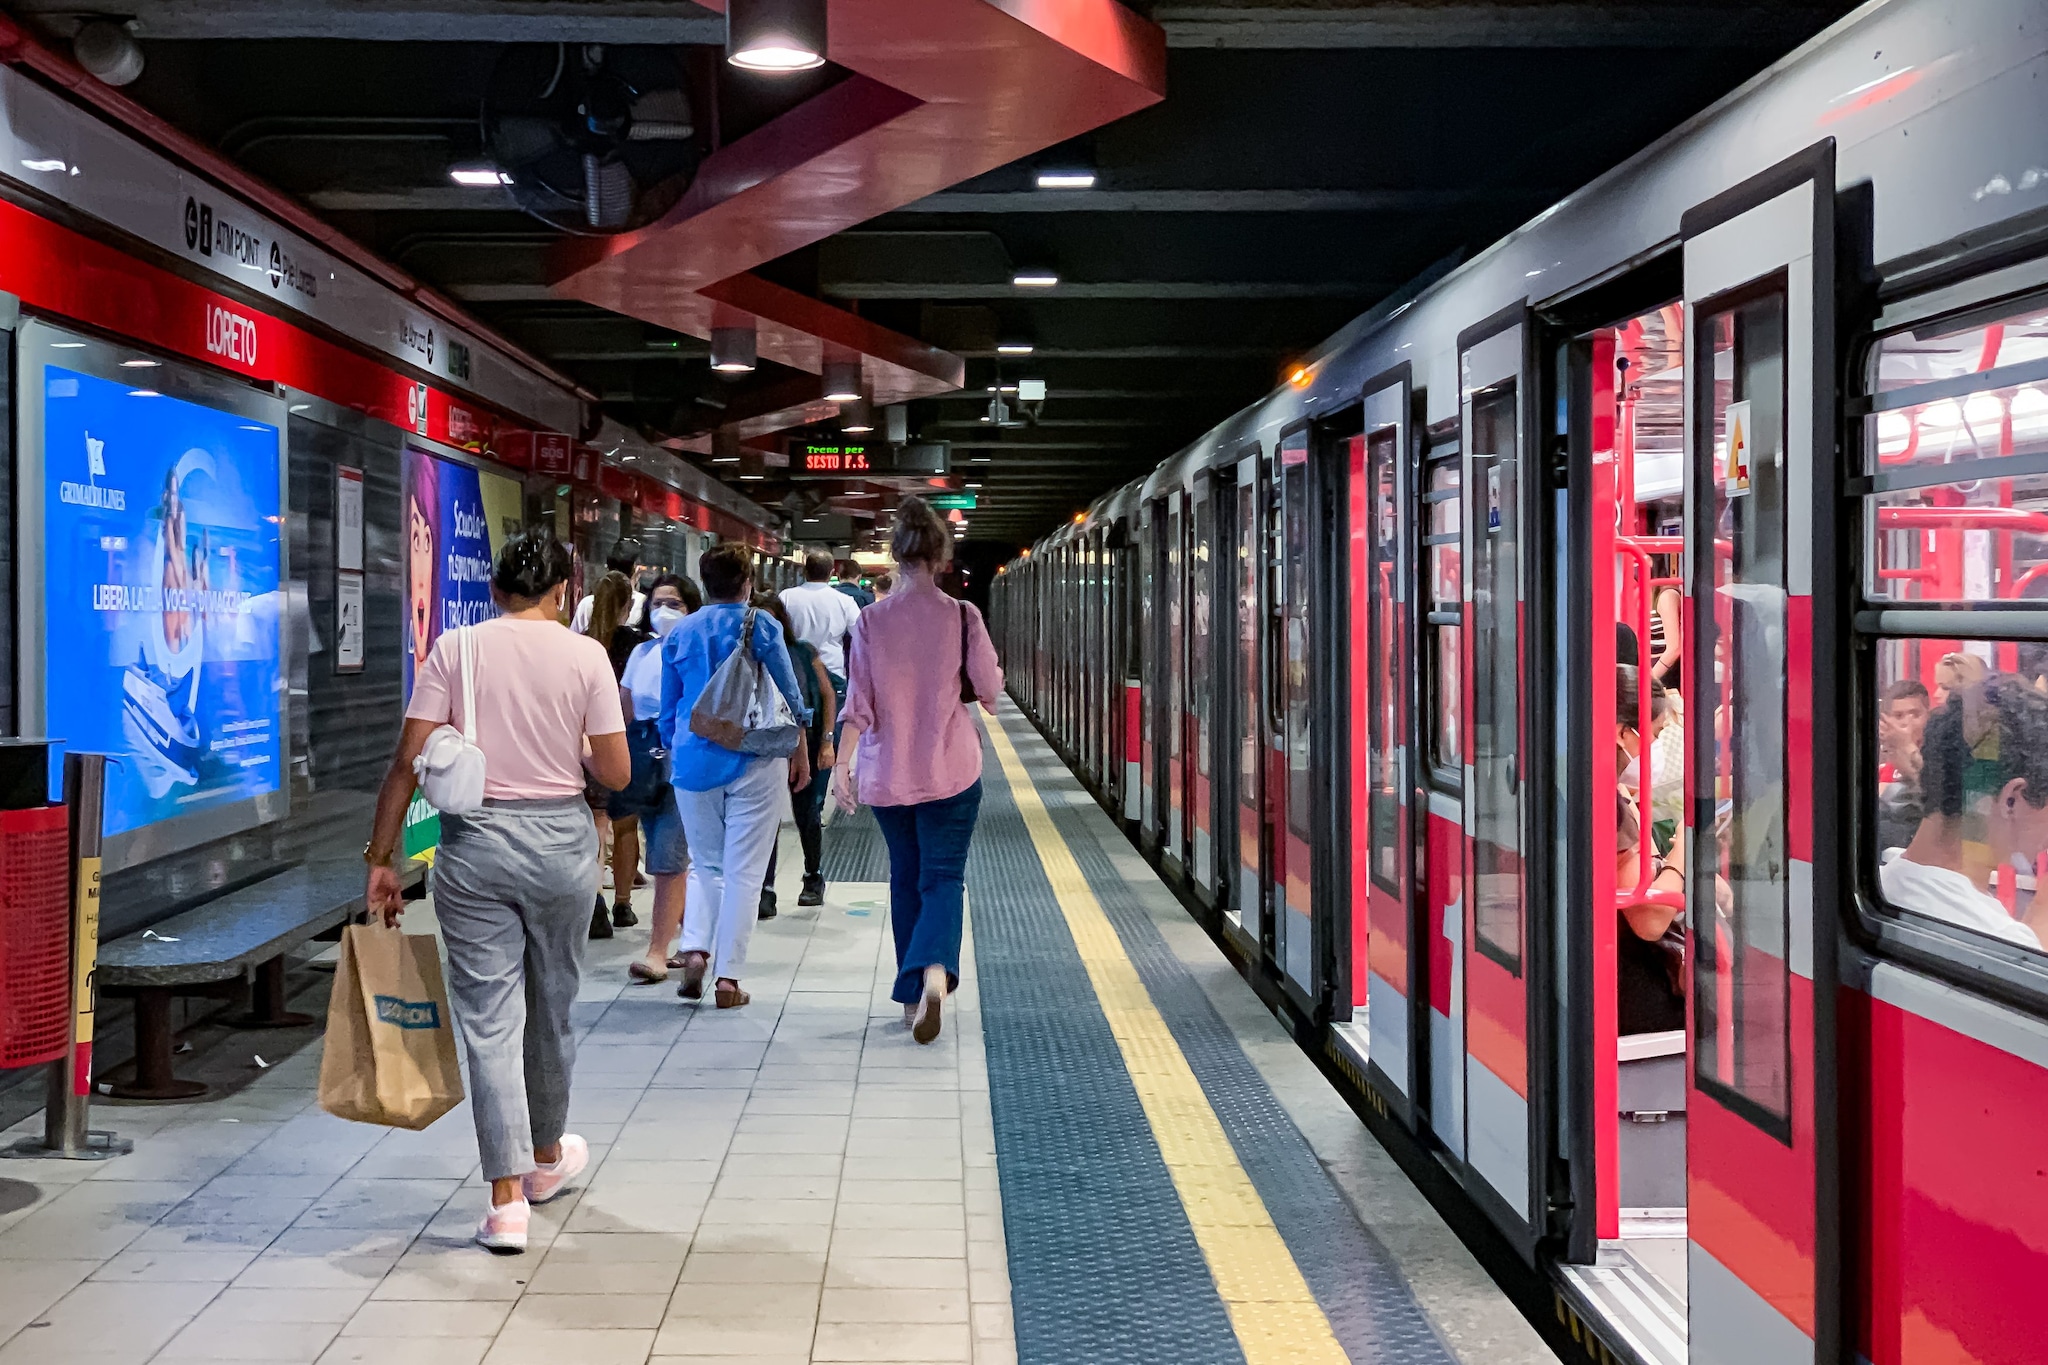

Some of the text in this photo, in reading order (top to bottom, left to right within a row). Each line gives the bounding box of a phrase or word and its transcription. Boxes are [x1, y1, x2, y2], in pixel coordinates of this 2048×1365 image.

[235, 229, 260, 264] POINT
[206, 303, 257, 367] LORETO
[541, 447, 564, 459] SOS
[806, 455, 869, 469] SESTO F.S.
[60, 481, 127, 511] GRIMALDI LINES
[93, 584, 130, 611] LIBERA
[131, 585, 144, 611] LA
